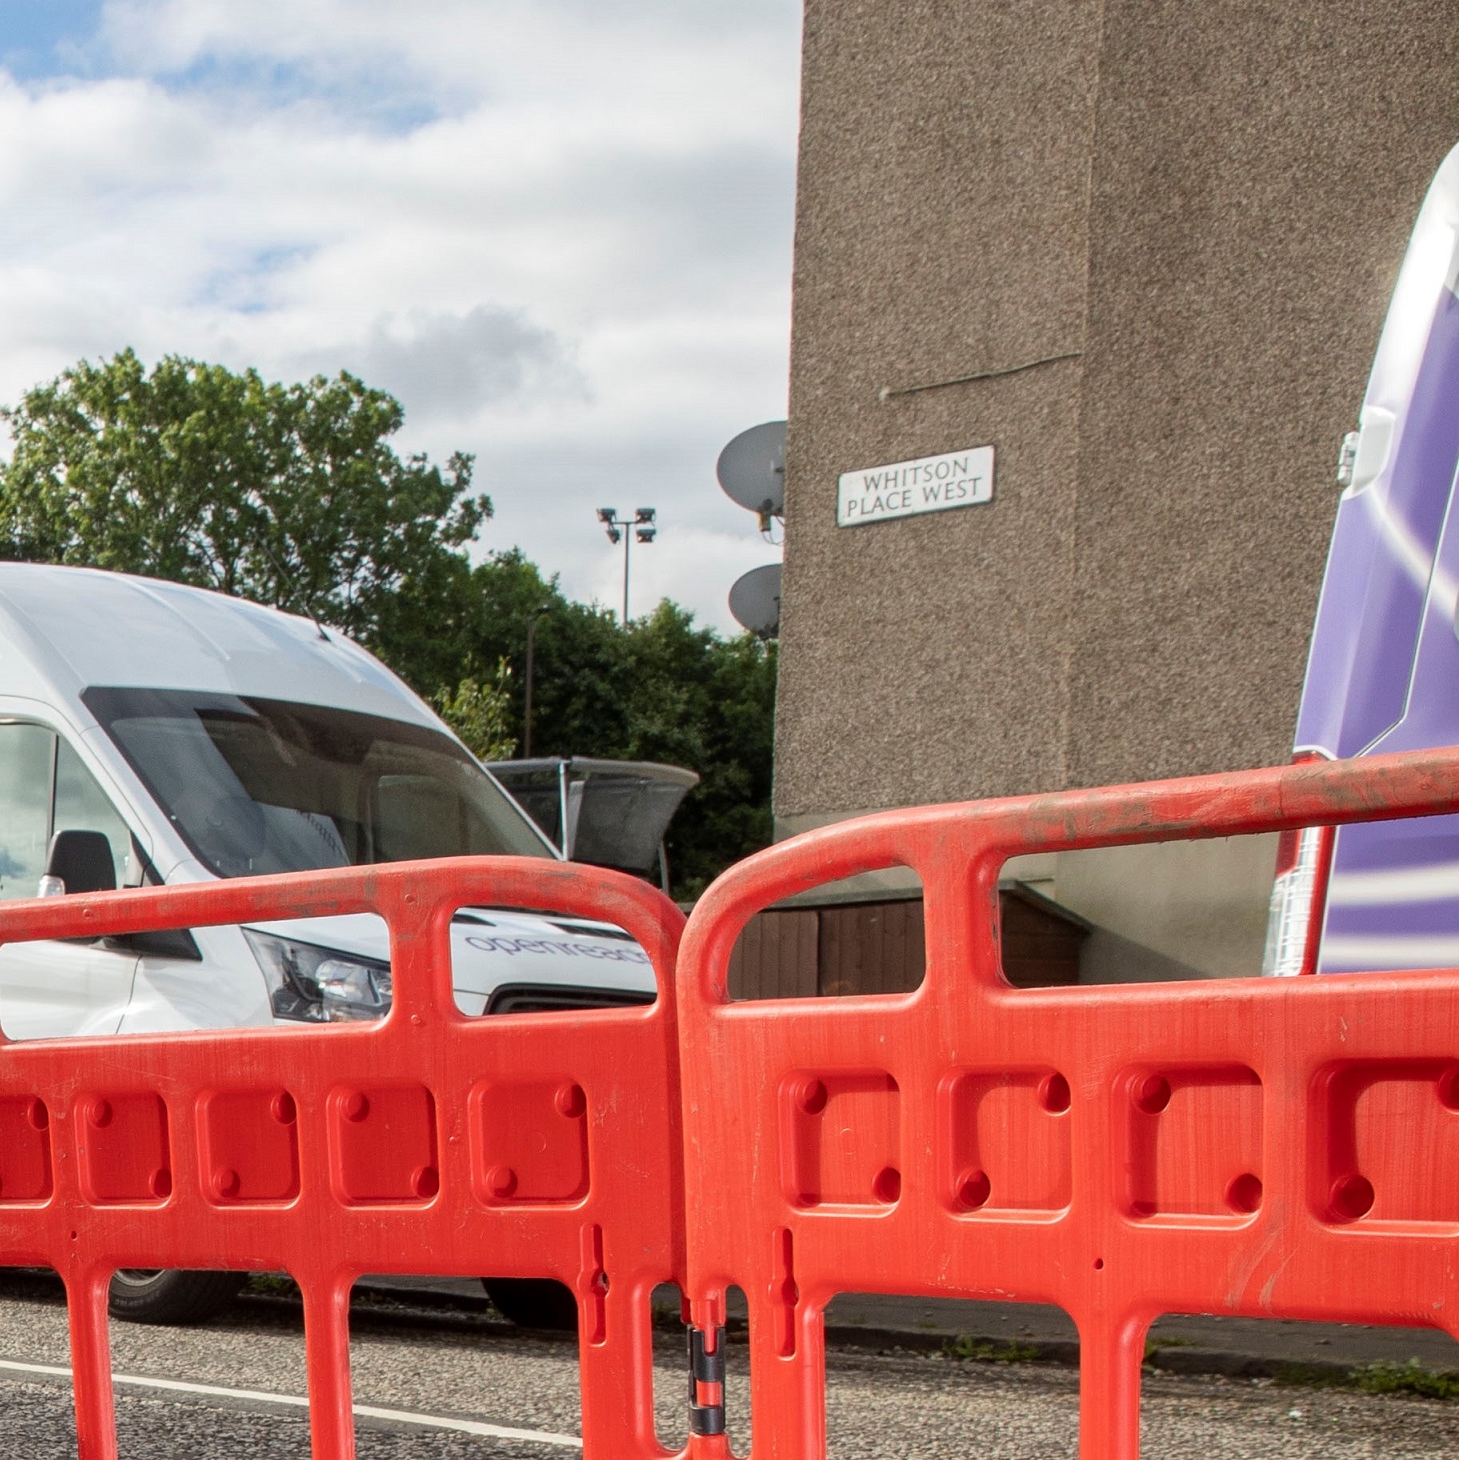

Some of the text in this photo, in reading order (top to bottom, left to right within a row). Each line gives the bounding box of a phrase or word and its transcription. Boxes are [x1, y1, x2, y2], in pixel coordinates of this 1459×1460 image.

[864, 457, 969, 492] WHITSON
[847, 476, 983, 518] PLACE WEST
[465, 935, 651, 965] openreac
